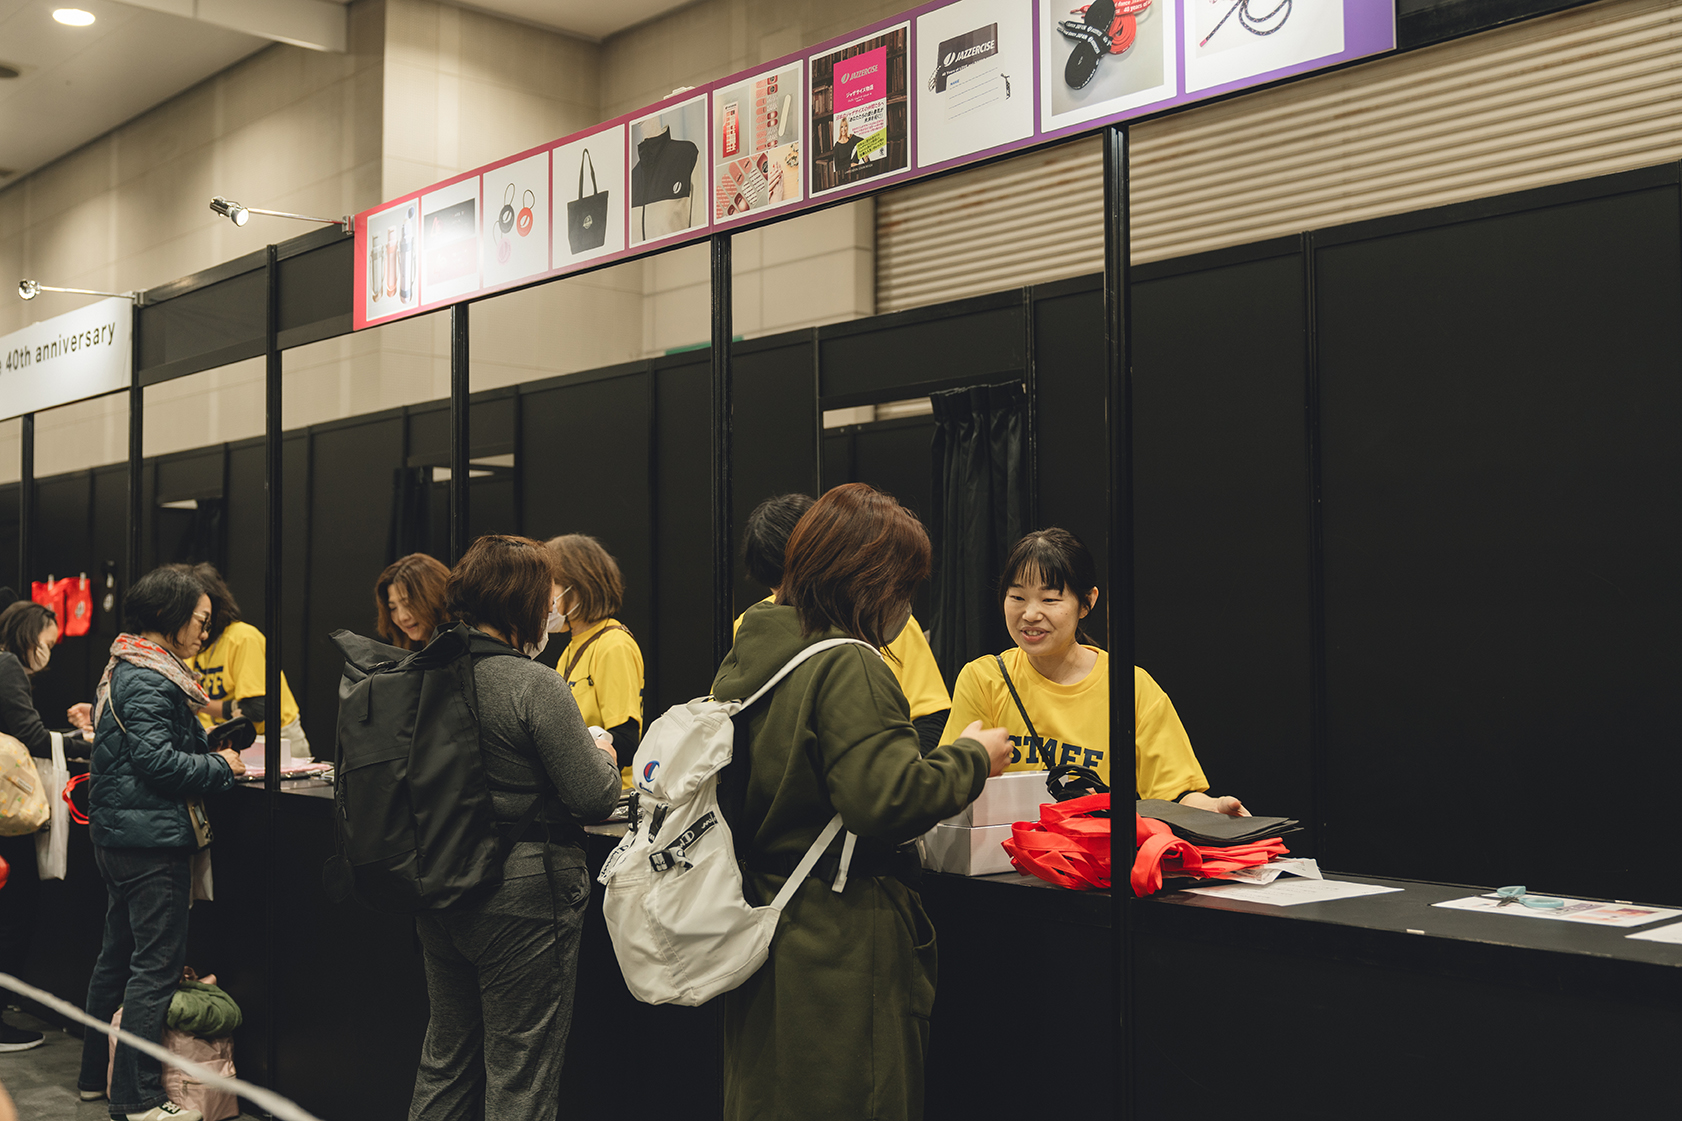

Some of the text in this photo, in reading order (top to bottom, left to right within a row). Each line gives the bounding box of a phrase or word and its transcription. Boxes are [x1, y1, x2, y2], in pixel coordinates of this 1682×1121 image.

[955, 40, 995, 63] JAZZERCISE
[849, 64, 878, 81] JAZZERCISE
[6, 322, 116, 372] 40th anniversary
